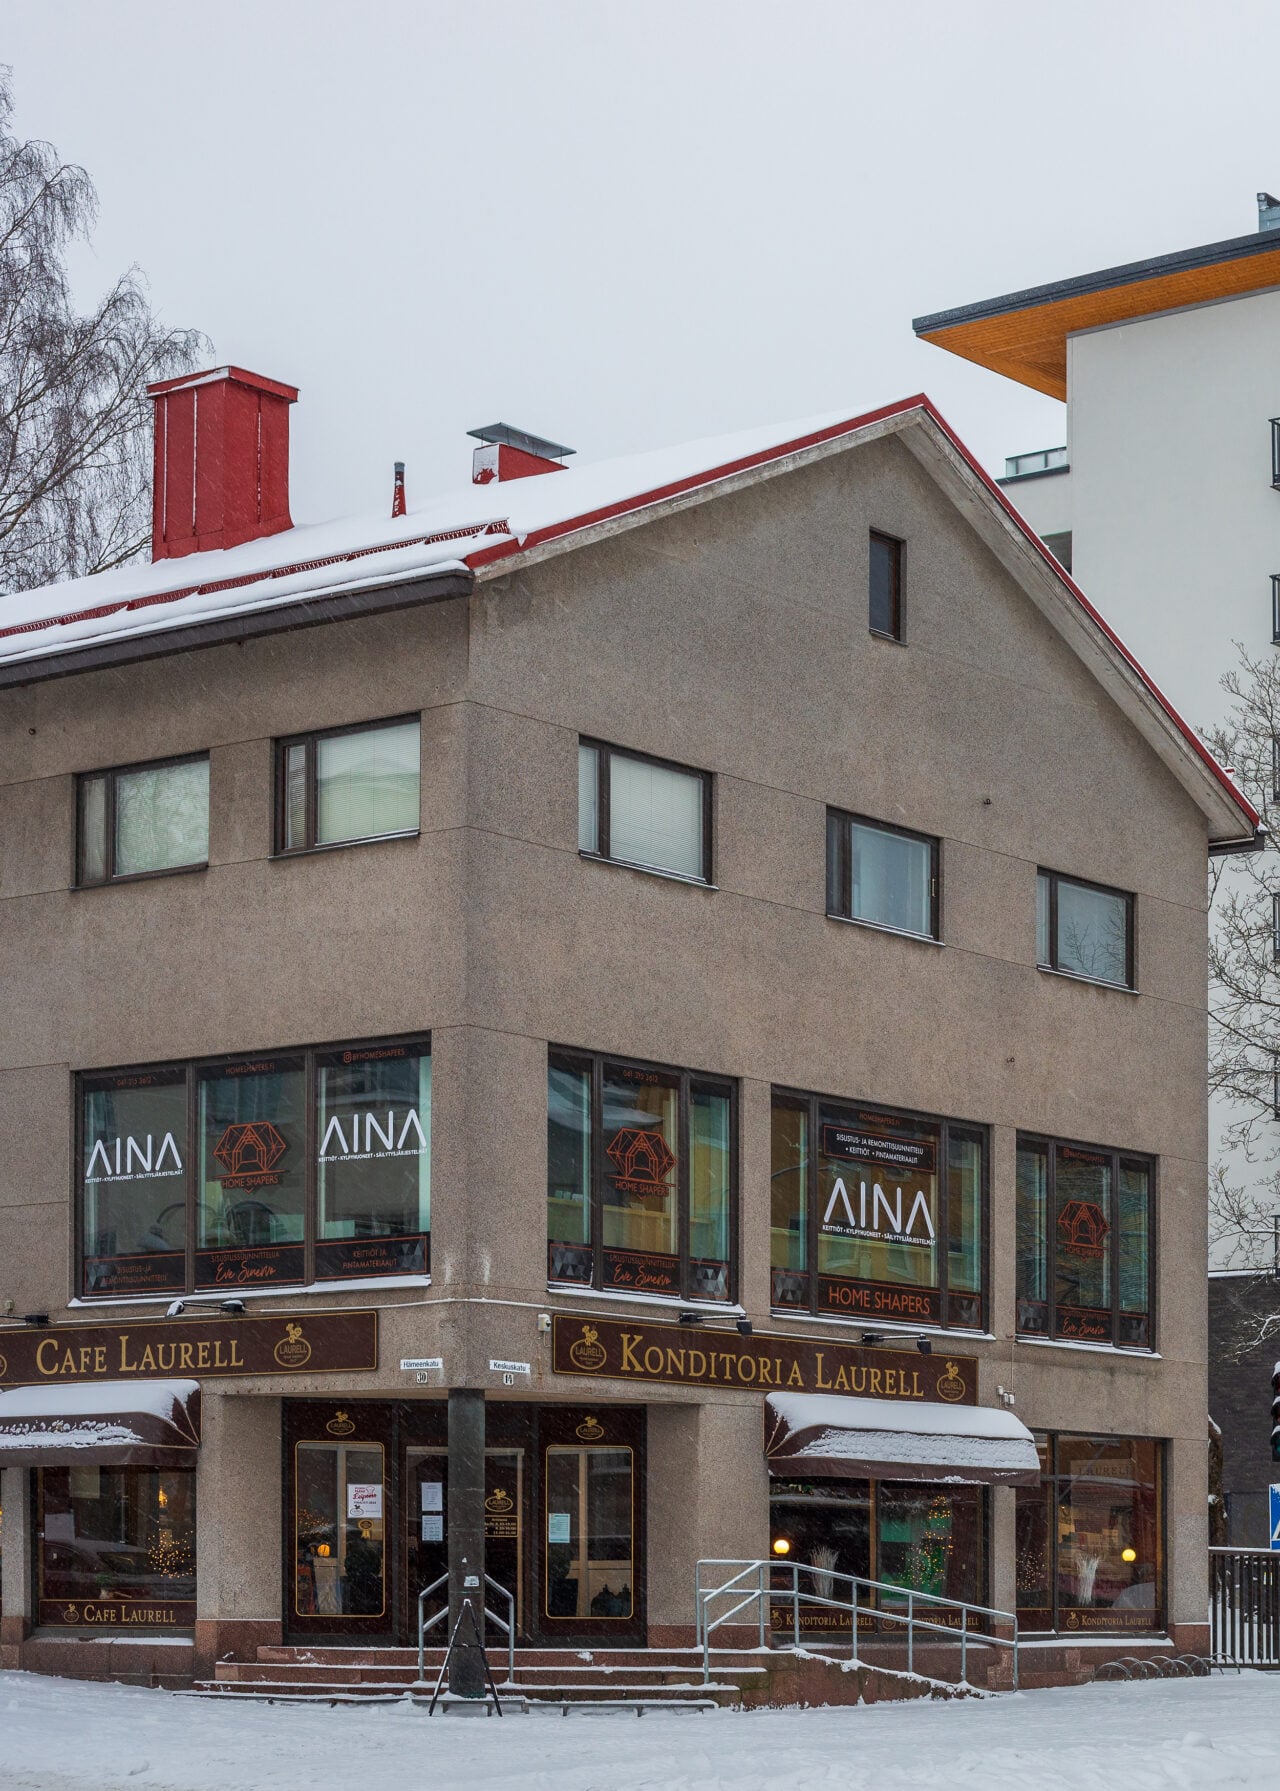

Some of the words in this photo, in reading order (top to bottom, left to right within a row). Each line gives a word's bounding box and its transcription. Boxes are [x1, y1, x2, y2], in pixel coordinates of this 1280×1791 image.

[319, 1108, 427, 1156] AINA
[836, 1133, 861, 1143] SISUSTUS-
[867, 1139, 924, 1155] REMONTTISUUNNITTELU
[86, 1132, 183, 1177] AINA
[849, 1146, 870, 1156] KEITTIÖT
[875, 1151, 918, 1164] PINTAMATERIAALIT
[222, 1177, 245, 1189] HOME
[246, 1175, 279, 1187] SHAPERS
[615, 1181, 638, 1192] HOME
[639, 1184, 670, 1197] SHAPERS
[823, 1177, 935, 1239] AINA
[828, 1285, 871, 1308] HOME
[874, 1291, 931, 1315] SHAPERS
[36, 1338, 107, 1375] CAFE
[118, 1335, 244, 1372] LAURELL
[279, 1344, 308, 1355] LAURELL
[575, 1346, 603, 1358] LAURELL
[403, 1361, 439, 1369] Hämeenkatu
[493, 1361, 527, 1372] Keskuskatu
[620, 1333, 804, 1387] KONDITORIA
[814, 1352, 924, 1397] LAURELL
[417, 1372, 427, 1383] 30
[504, 1373, 513, 1384] 14
[83, 1604, 117, 1622] CAFE
[121, 1605, 177, 1623] LAURELL
[1081, 1615, 1123, 1626] KONDITORIA
[1125, 1615, 1152, 1626] LAURELL
